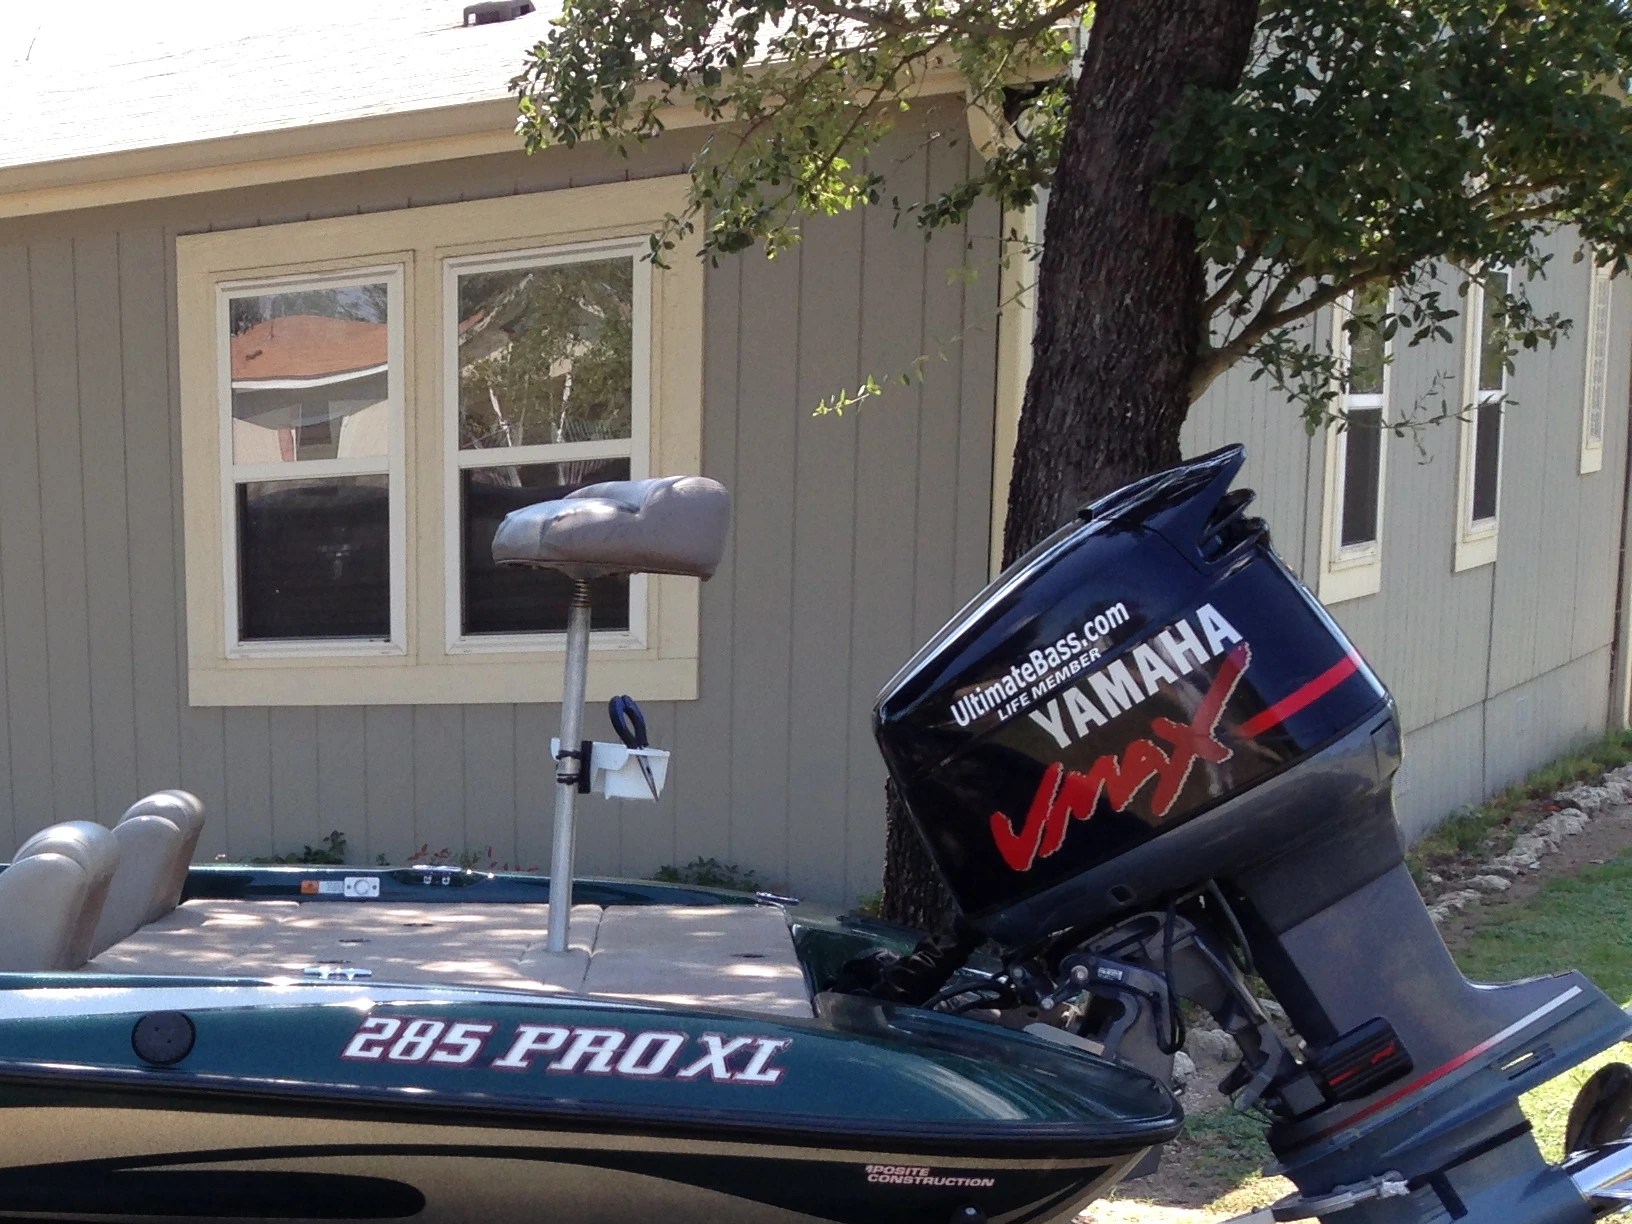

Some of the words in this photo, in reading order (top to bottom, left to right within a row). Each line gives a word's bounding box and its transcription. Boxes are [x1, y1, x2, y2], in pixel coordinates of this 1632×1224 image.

[950, 602, 1131, 728] UltimateBass.com
[997, 698, 1031, 722] LIFE
[1031, 647, 1102, 701] MEMBER
[1028, 603, 1243, 749] YAMAHA
[343, 1016, 494, 1064] 285
[491, 1023, 687, 1076] PRO
[678, 1032, 794, 1084] XL
[867, 1173, 995, 1187] CONSTRUCTION
